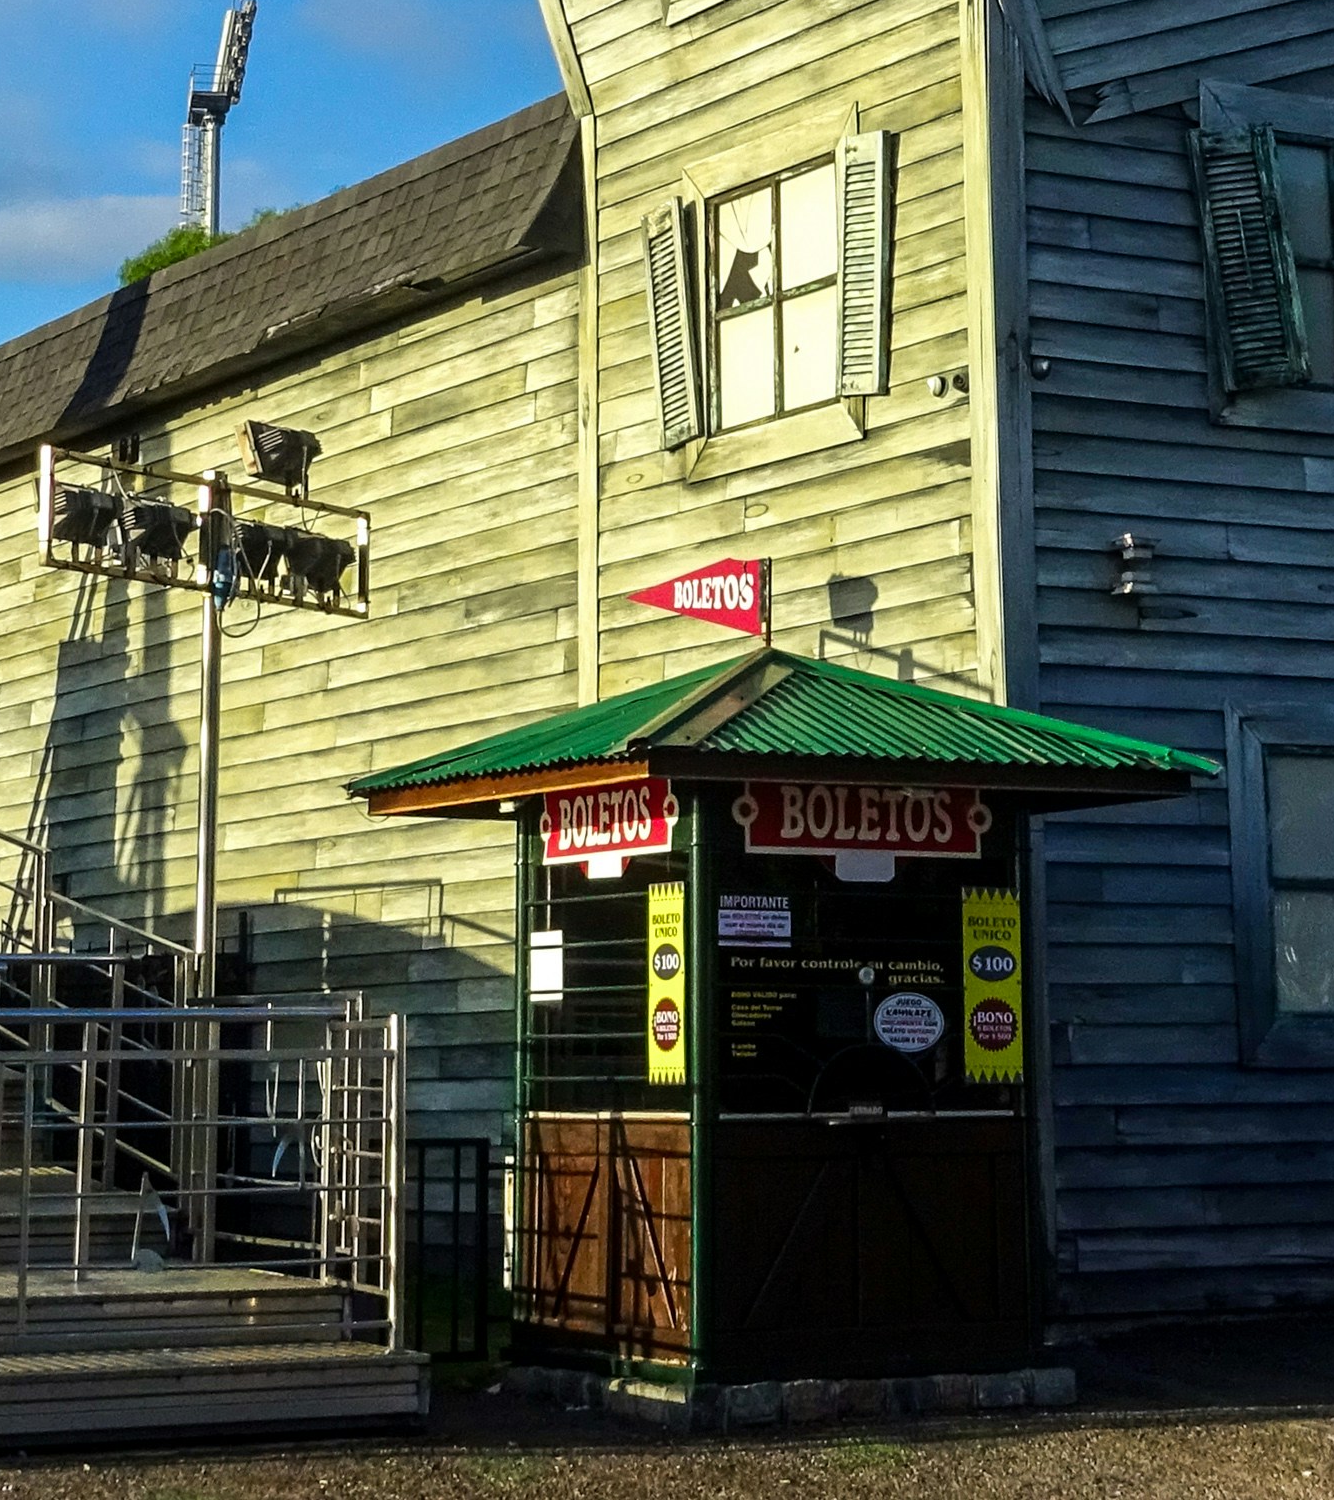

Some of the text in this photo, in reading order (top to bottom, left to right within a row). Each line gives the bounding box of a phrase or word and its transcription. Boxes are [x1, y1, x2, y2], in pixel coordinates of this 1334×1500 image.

[673, 573, 754, 610] BOLETOS
[558, 786, 652, 850] BOLETOS
[779, 785, 953, 843] BOLETOS
[719, 895, 789, 909] IMPORTANTE
[652, 913, 681, 925] BOLETO
[968, 917, 1016, 928] BOLETO
[655, 925, 678, 938] UNICO
[973, 929, 1011, 942] UNICO
[730, 956, 753, 968] Por
[759, 956, 797, 968] favor
[801, 956, 861, 969] controle
[888, 959, 944, 972] cambio,
[888, 975, 945, 986] gracias.
[895, 998, 922, 1006] JUEGO
